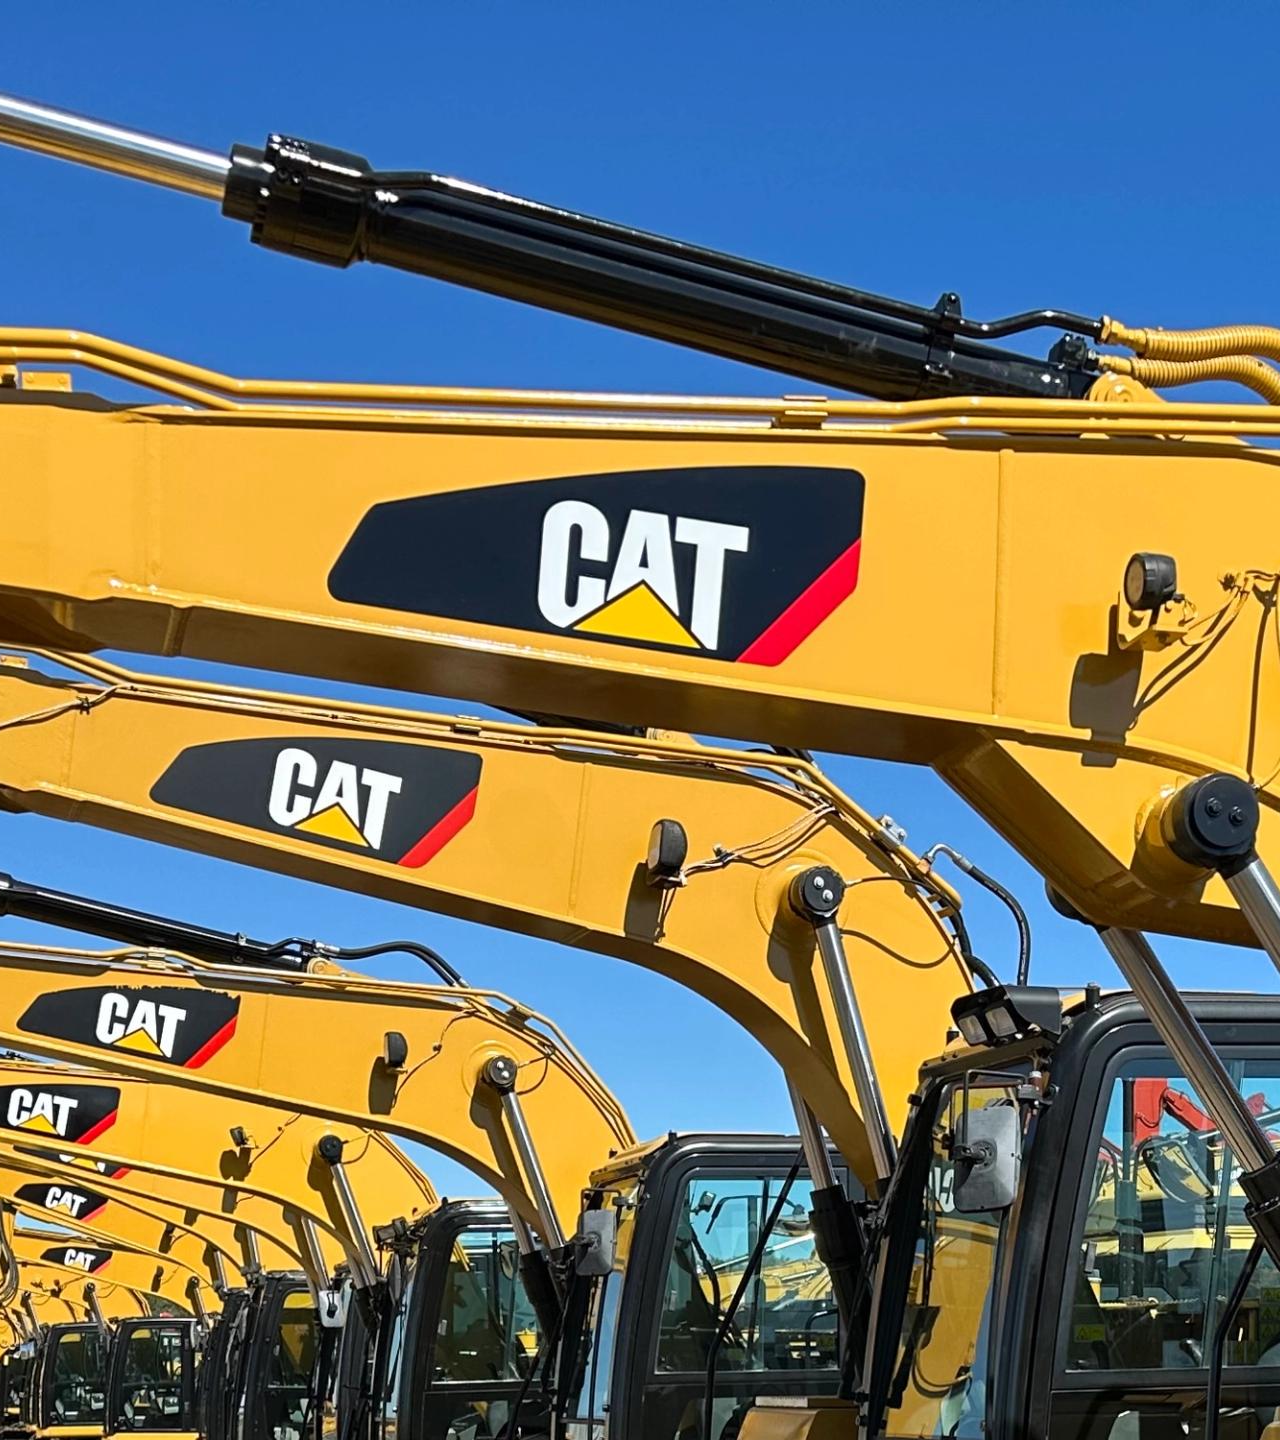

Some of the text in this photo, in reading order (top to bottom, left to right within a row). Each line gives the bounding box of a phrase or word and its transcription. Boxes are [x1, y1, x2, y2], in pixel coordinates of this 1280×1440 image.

[538, 499, 750, 651] CAT
[269, 747, 403, 850] CAT
[95, 992, 187, 1058] CAT
[7, 1088, 79, 1137] CAT
[45, 1186, 88, 1218] CAT
[64, 1248, 96, 1272] CAT
